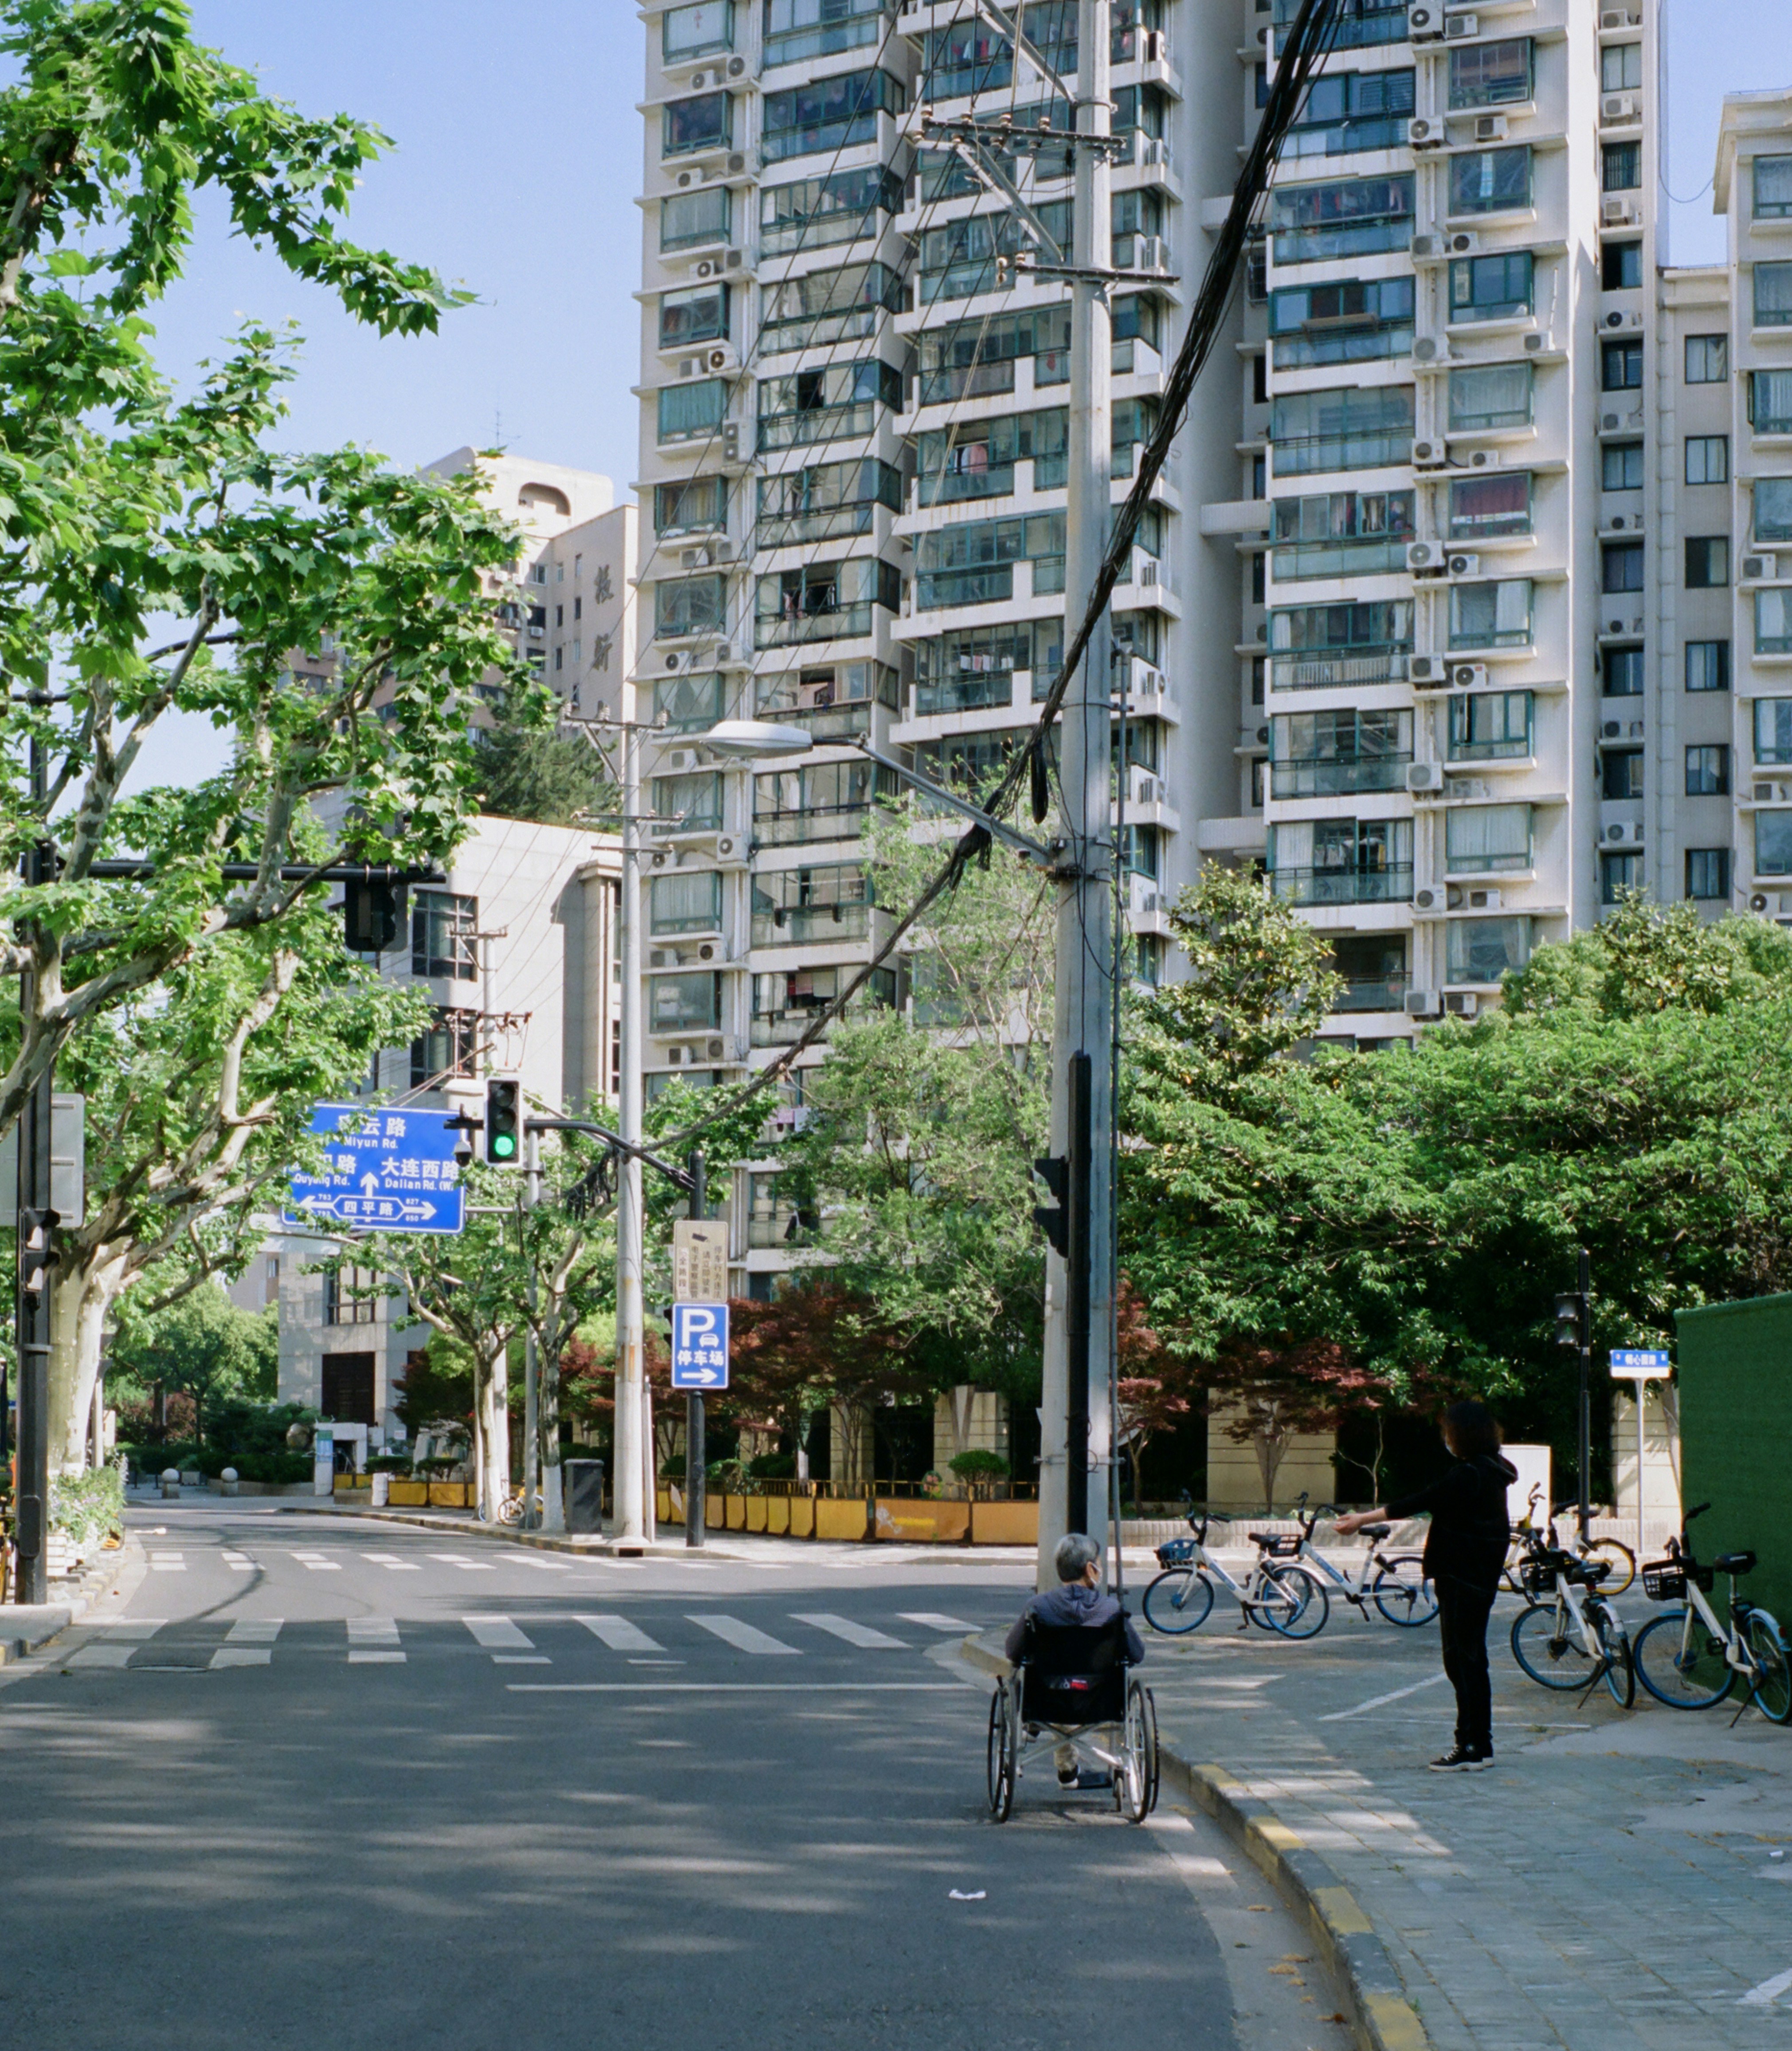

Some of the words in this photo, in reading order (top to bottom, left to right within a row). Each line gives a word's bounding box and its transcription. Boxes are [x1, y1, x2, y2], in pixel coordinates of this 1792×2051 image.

[344, 1136, 378, 1149] Miyun
[382, 1139, 398, 1149] Rd.
[380, 1157, 459, 1180] 大连西路
[333, 1175, 350, 1186] Rd.
[384, 1178, 421, 1190] Dalian
[423, 1179, 437, 1191] Rd.
[344, 1201, 394, 1216] 四平路
[682, 1309, 715, 1347] P
[678, 1350, 724, 1366] 停车场
